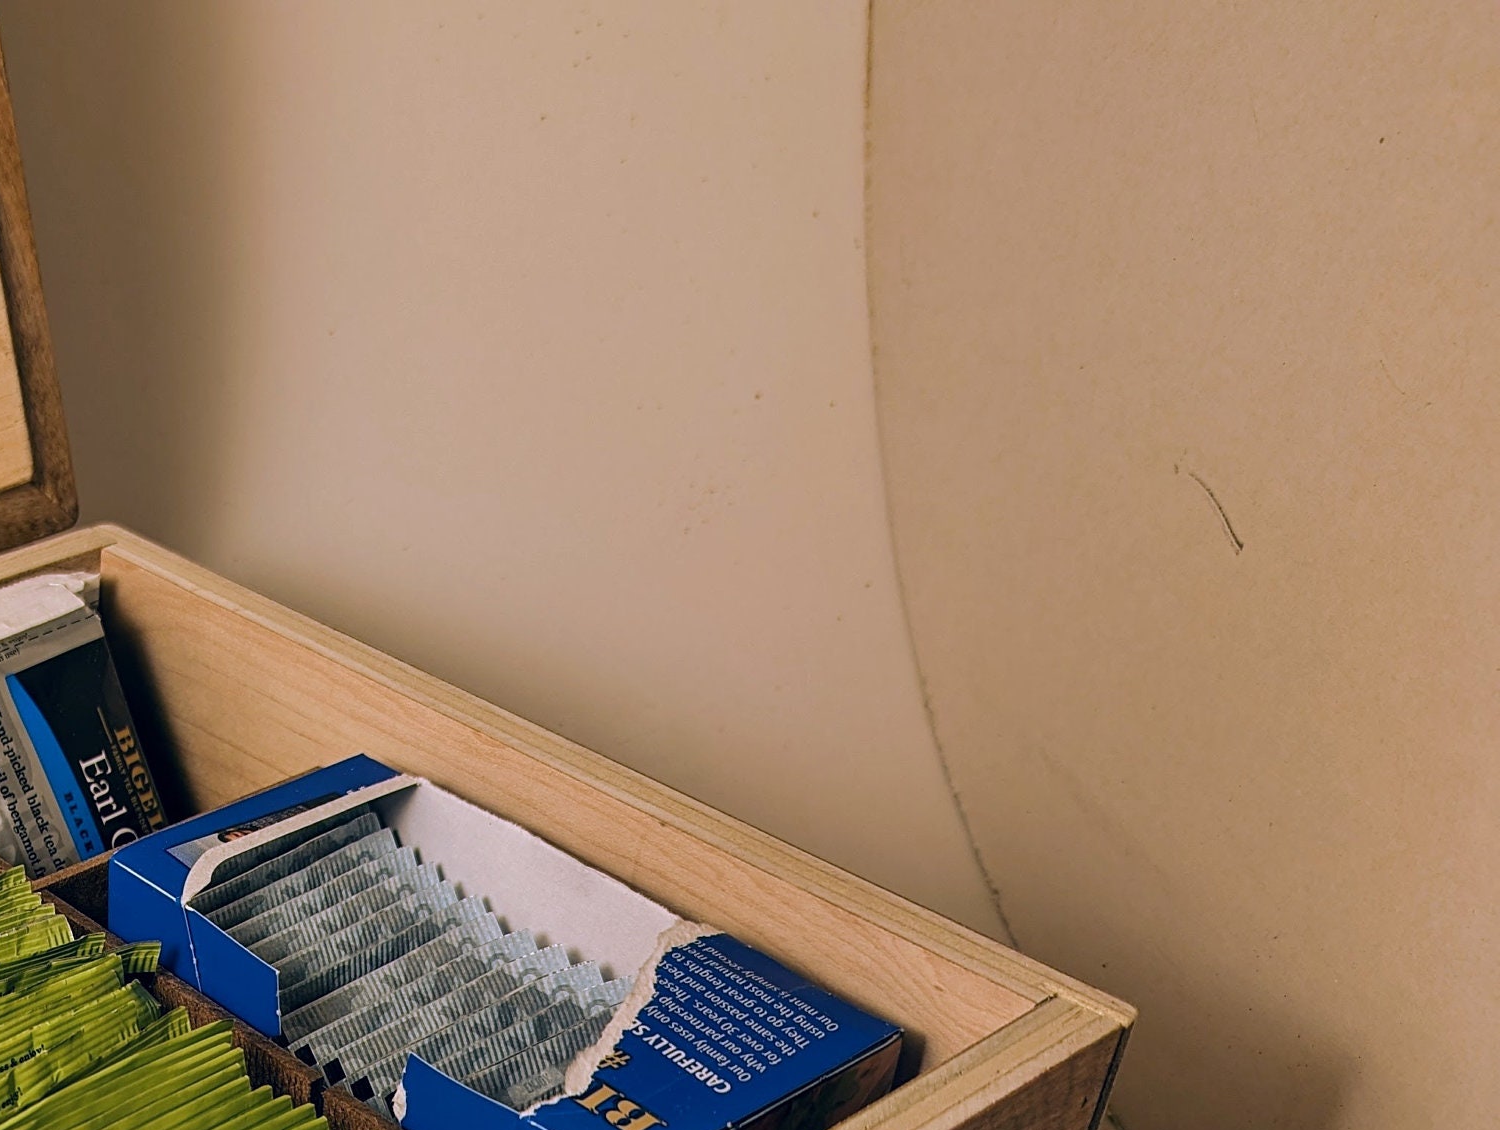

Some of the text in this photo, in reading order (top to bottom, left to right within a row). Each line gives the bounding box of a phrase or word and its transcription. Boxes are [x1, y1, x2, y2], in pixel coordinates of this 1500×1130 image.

[0, 785, 16, 801] of
[78, 749, 128, 825] Earl
[7, 795, 44, 867] bergamot
[26, 793, 49, 835] black
[43, 834, 58, 859] tea
[63, 791, 95, 855] BLACK
[653, 959, 685, 980] best
[702, 946, 744, 971] second
[703, 959, 747, 985] natural
[741, 970, 781, 992] simply
[653, 977, 692, 1003] These
[679, 976, 707, 993] and
[743, 982, 775, 1005] most
[778, 990, 791, 999] is
[671, 952, 811, 1050] They go to great lengths to
[692, 999, 728, 1025] years.
[703, 990, 750, 1021] passion
[773, 1001, 795, 1019] the
[788, 997, 819, 1017] mint
[658, 996, 767, 1073] why our partnership
[720, 1022, 741, 1036] 30
[744, 1018, 777, 1042] same
[792, 1014, 826, 1039] using
[815, 1014, 839, 1032] Our
[638, 1003, 752, 1082] Our family uses only
[736, 1032, 765, 1052] over
[774, 1039, 797, 1057] the
[9, 1055, 19, 1069] &
[642, 1033, 731, 1094] CAREFULLY
[761, 1050, 782, 1065] for
